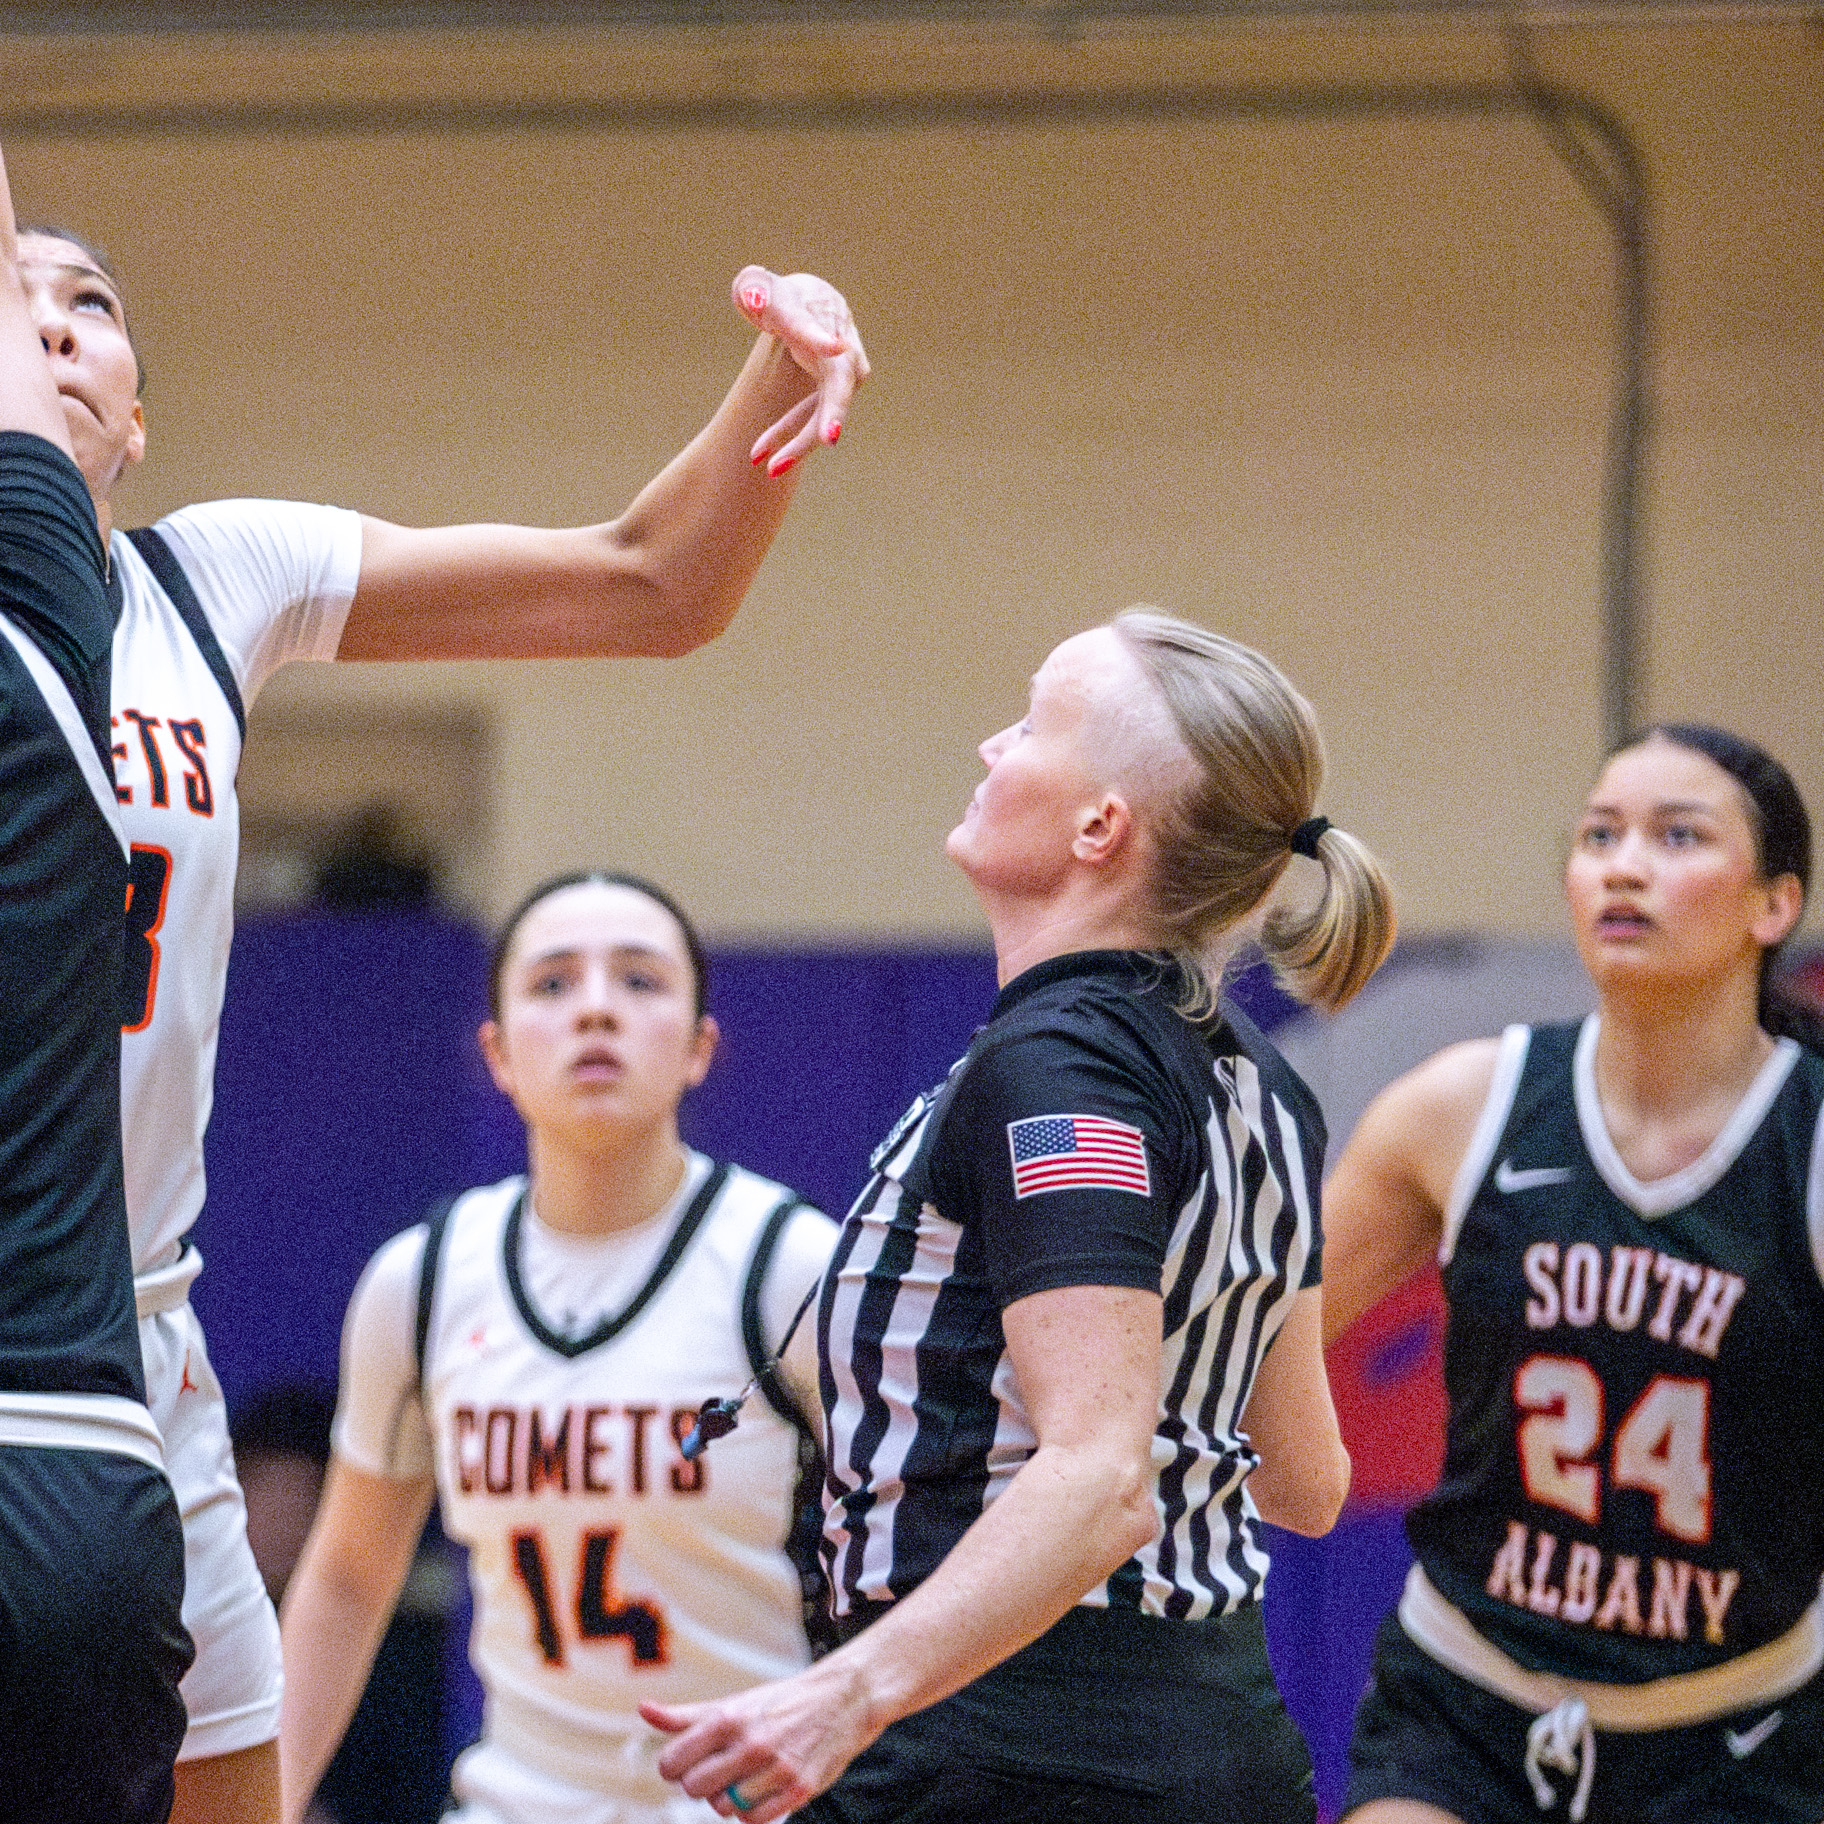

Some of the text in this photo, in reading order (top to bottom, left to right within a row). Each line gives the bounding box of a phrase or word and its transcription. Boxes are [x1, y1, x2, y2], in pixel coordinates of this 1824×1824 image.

[1522, 1239, 1747, 1360] SOUTH
[454, 1403, 708, 1496] COMETS
[1513, 1352, 1713, 1544] 24
[511, 1524, 668, 1668] 14
[1484, 1519, 1740, 1646] ALBANY
